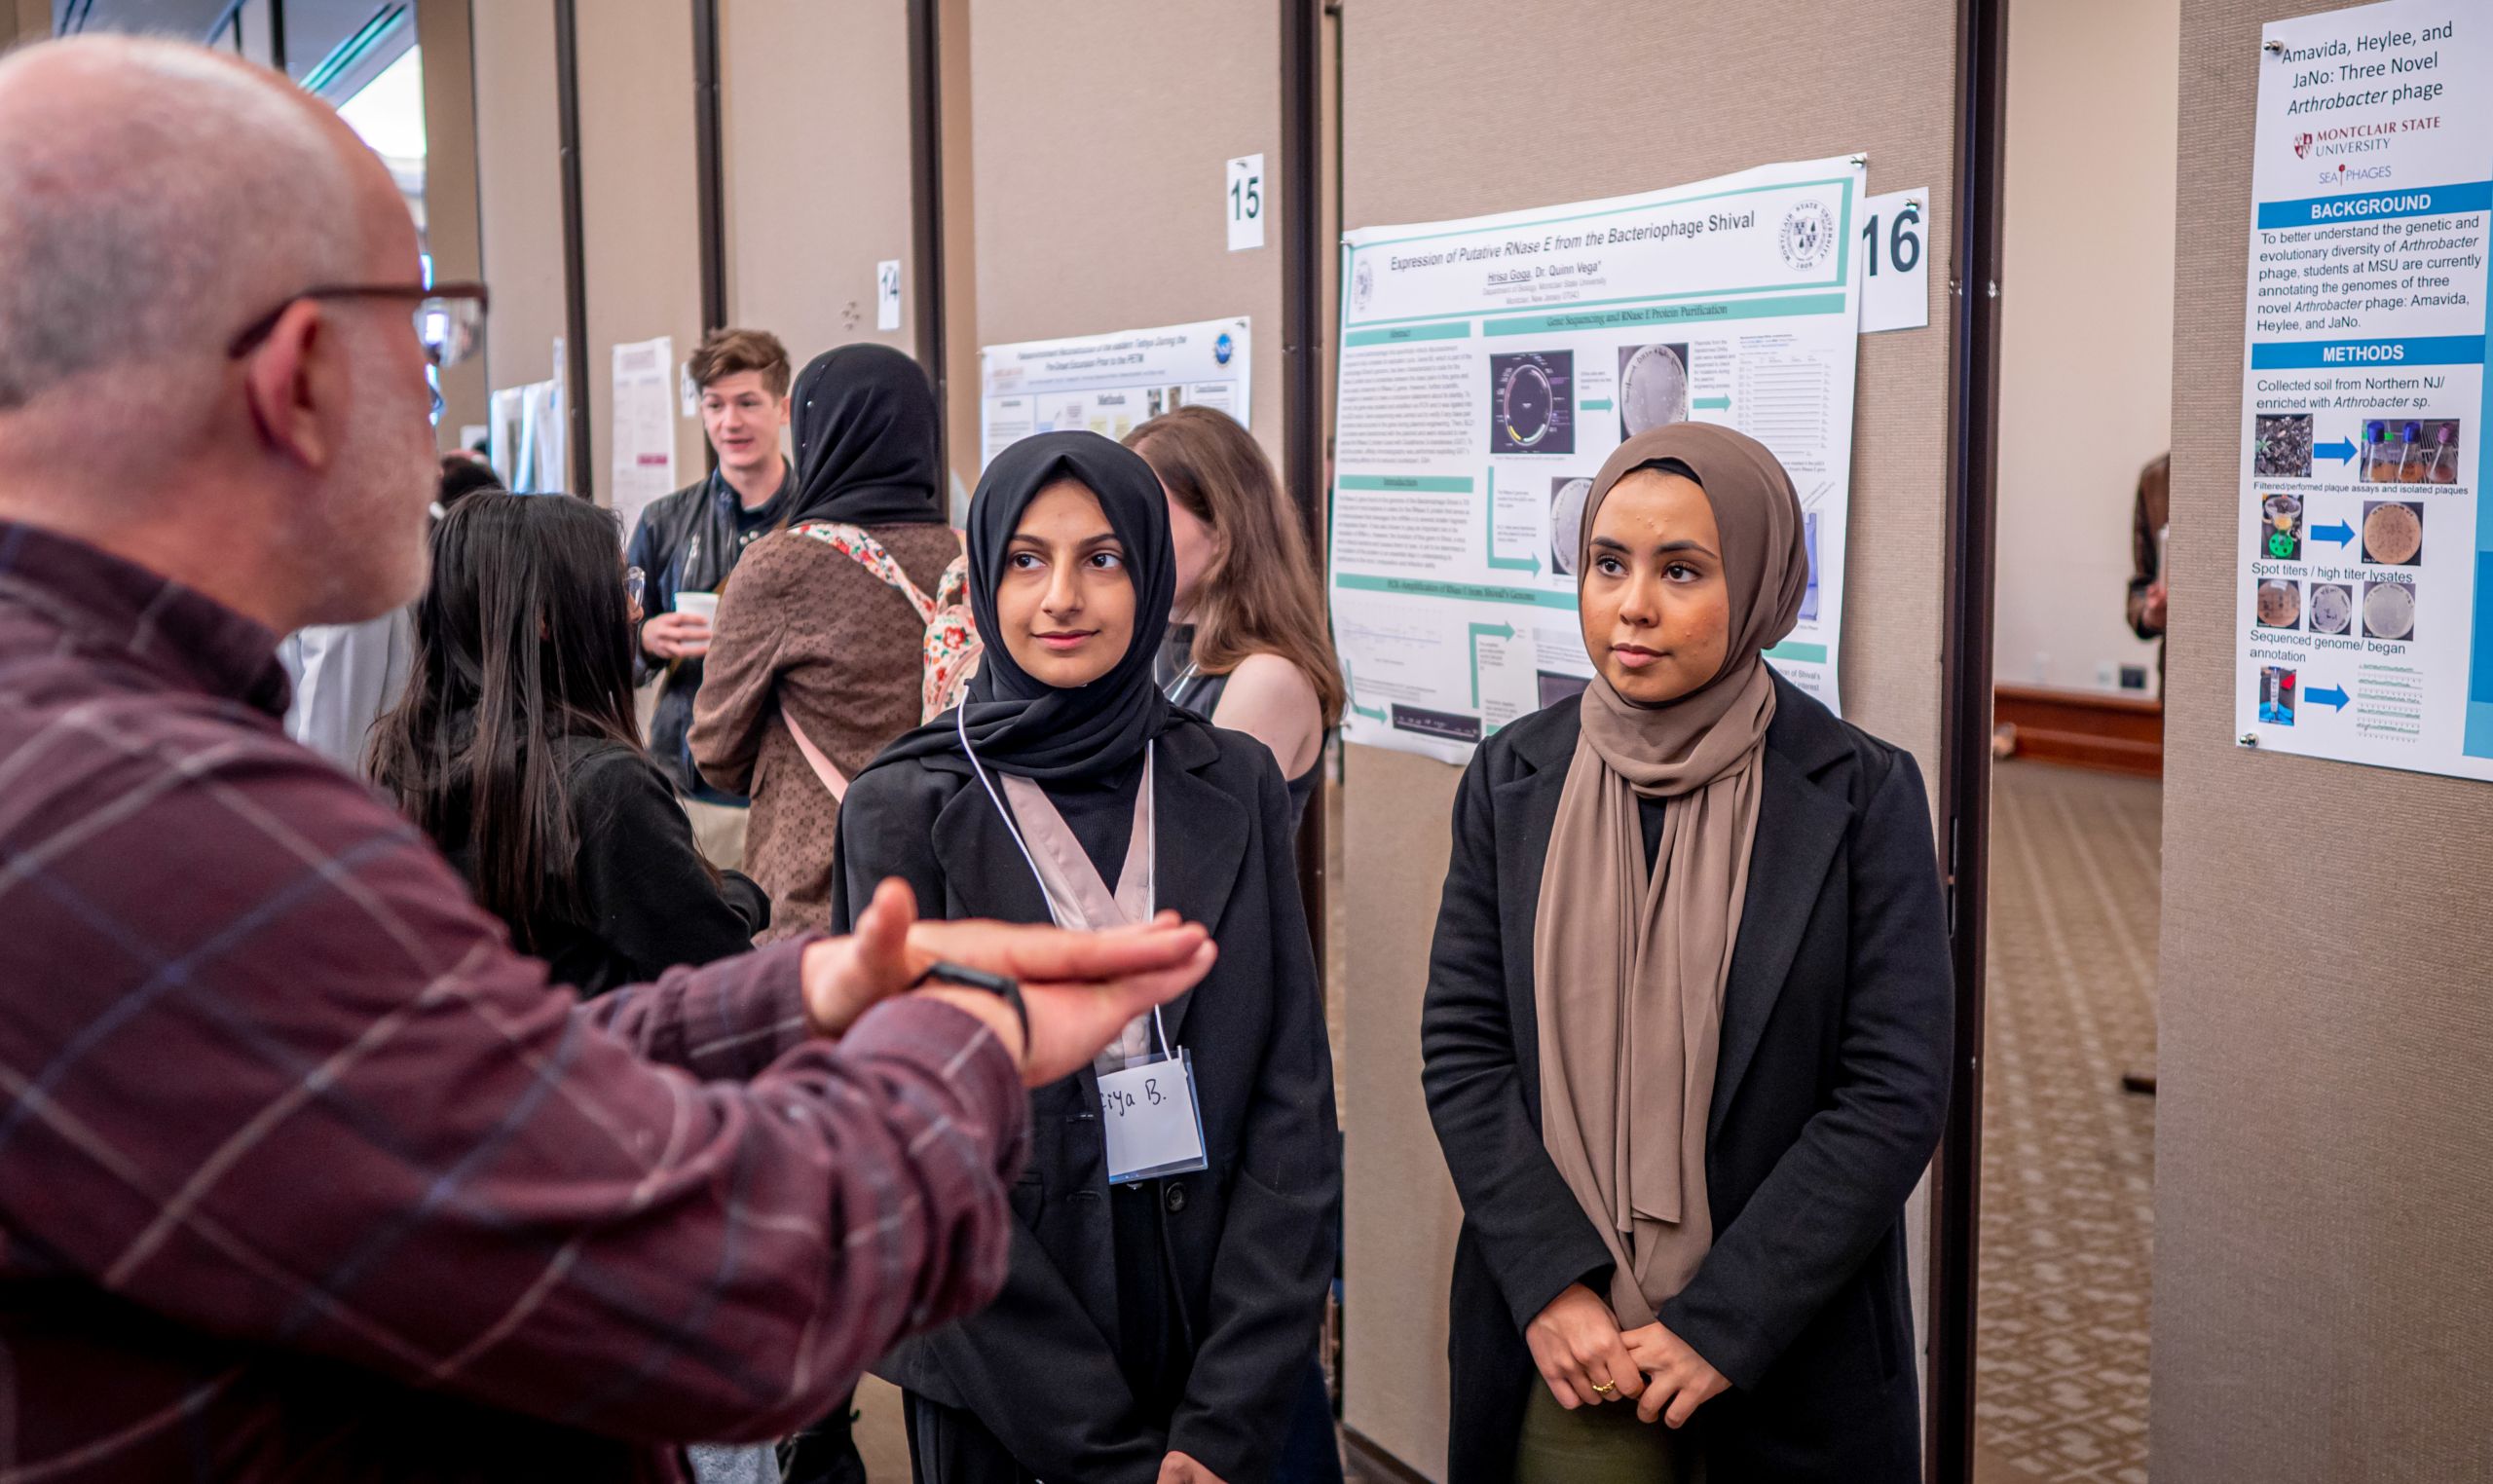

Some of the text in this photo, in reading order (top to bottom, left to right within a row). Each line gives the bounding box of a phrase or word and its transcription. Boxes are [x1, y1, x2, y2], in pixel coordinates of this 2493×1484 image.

[2282, 20, 2453, 64] Amavida, Heylee, and
[2292, 52, 2438, 89] JaNo: Three Novel
[2288, 82, 2443, 116] Arthrobacter phage
[2317, 116, 2441, 142] MONTCLAIR STATE
[2316, 138, 2391, 157] UNIVERSITY
[2319, 166, 2392, 184] SEA PHAGES
[1231, 176, 1259, 221] 15
[2311, 194, 2432, 220] BACKGROUND
[1391, 209, 1755, 273] Expression of Putative RNase E from the Bacteriophage Shival
[2261, 215, 2479, 244] To better understand the genetic and
[1862, 208, 1921, 277] 16
[2259, 235, 2479, 264] evolutionary diversity of Arthrobacter
[2258, 253, 2481, 282] phage, students at MSU are currently
[880, 271, 899, 302] 14
[2258, 276, 2450, 298] annotating the genomes of three
[1681, 302, 1728, 317] Purification
[2257, 291, 2470, 315] novel Arthrobacter phage: Amavida,
[2257, 315, 2361, 333] Heylee, and JaNo.
[2323, 345, 2404, 362] METHODS
[2256, 376, 2445, 392] Collected soil from Northern NJ/
[2256, 395, 2431, 410] enriched with Arthrobacter sp.
[2253, 481, 2469, 496] Filtered/performed plaque assays and isolated plaques
[2251, 562, 2280, 578] Spot
[2283, 564, 2308, 576] titers
[2318, 568, 2340, 581] high
[2344, 569, 2365, 580] titer
[2370, 570, 2413, 583] lysates
[2251, 630, 2405, 655] Sequenced genome/ began
[2250, 648, 2306, 663] annotation
[1144, 1078, 1167, 1105] B.
